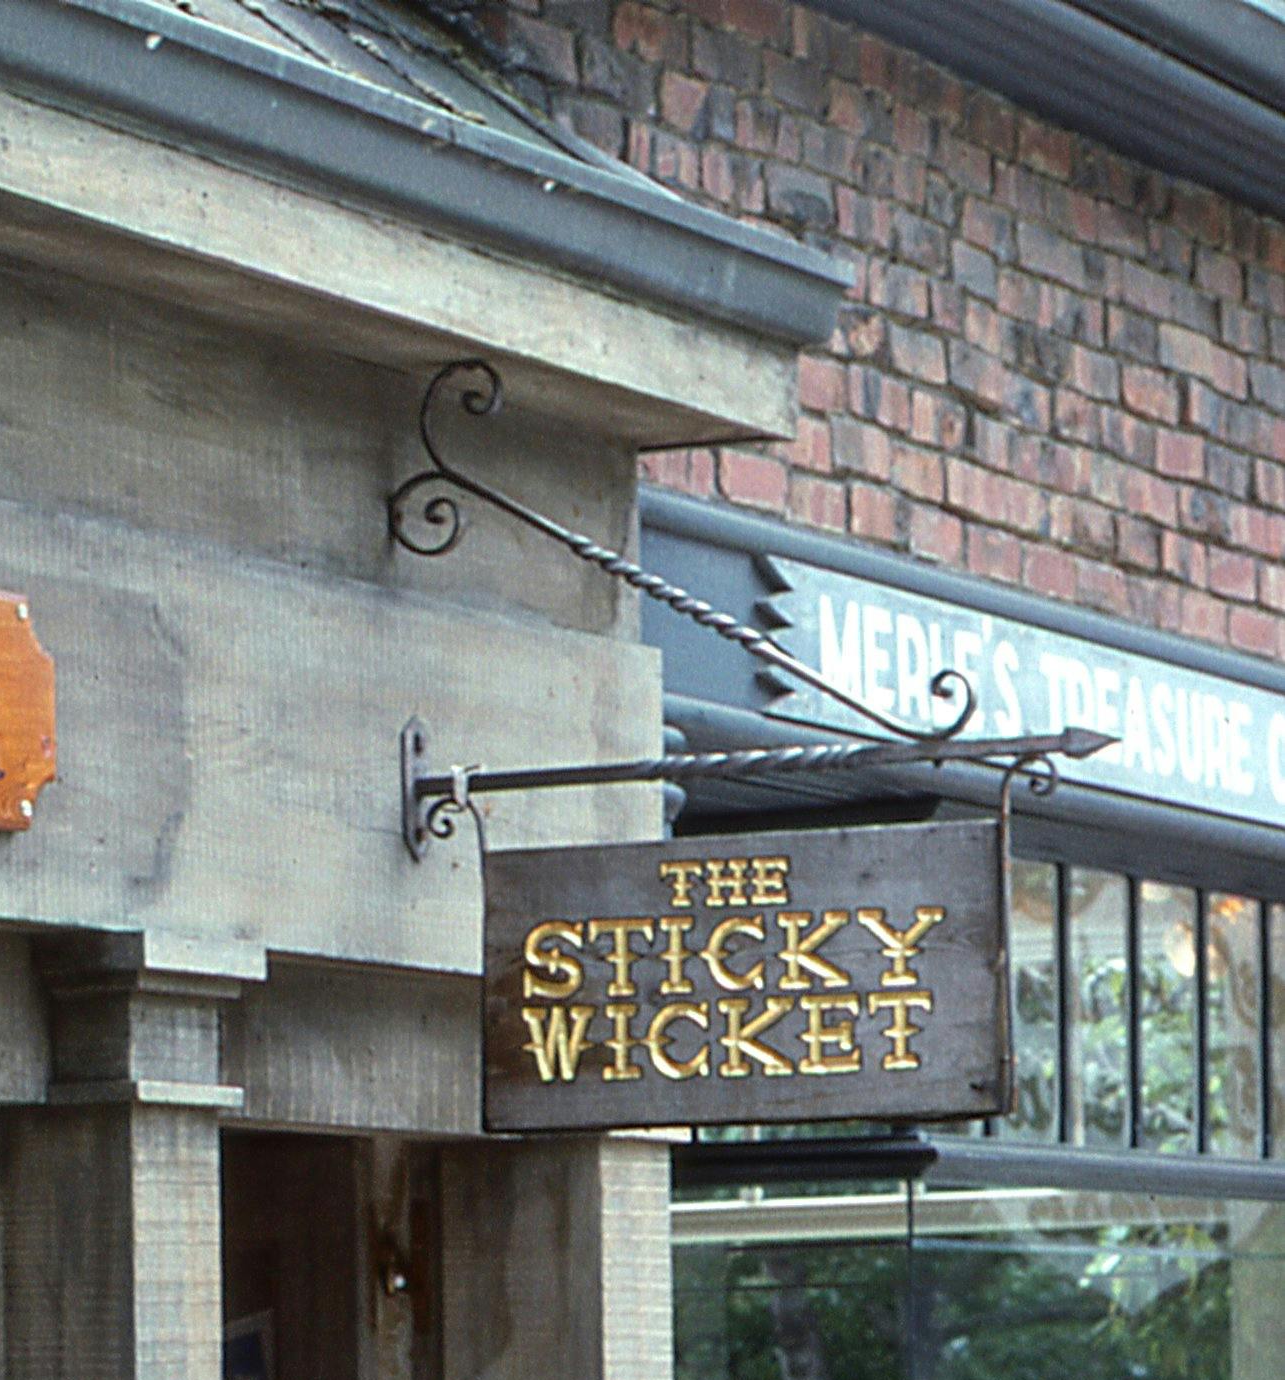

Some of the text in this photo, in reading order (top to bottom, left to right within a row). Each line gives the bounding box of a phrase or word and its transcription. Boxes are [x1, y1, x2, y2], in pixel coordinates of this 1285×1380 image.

[818, 593, 1022, 738] MERLE'S
[1038, 652, 1255, 797] TREASURE
[660, 855, 791, 907] THE
[523, 906, 946, 999] STICKY
[522, 990, 933, 1082] WICKET
